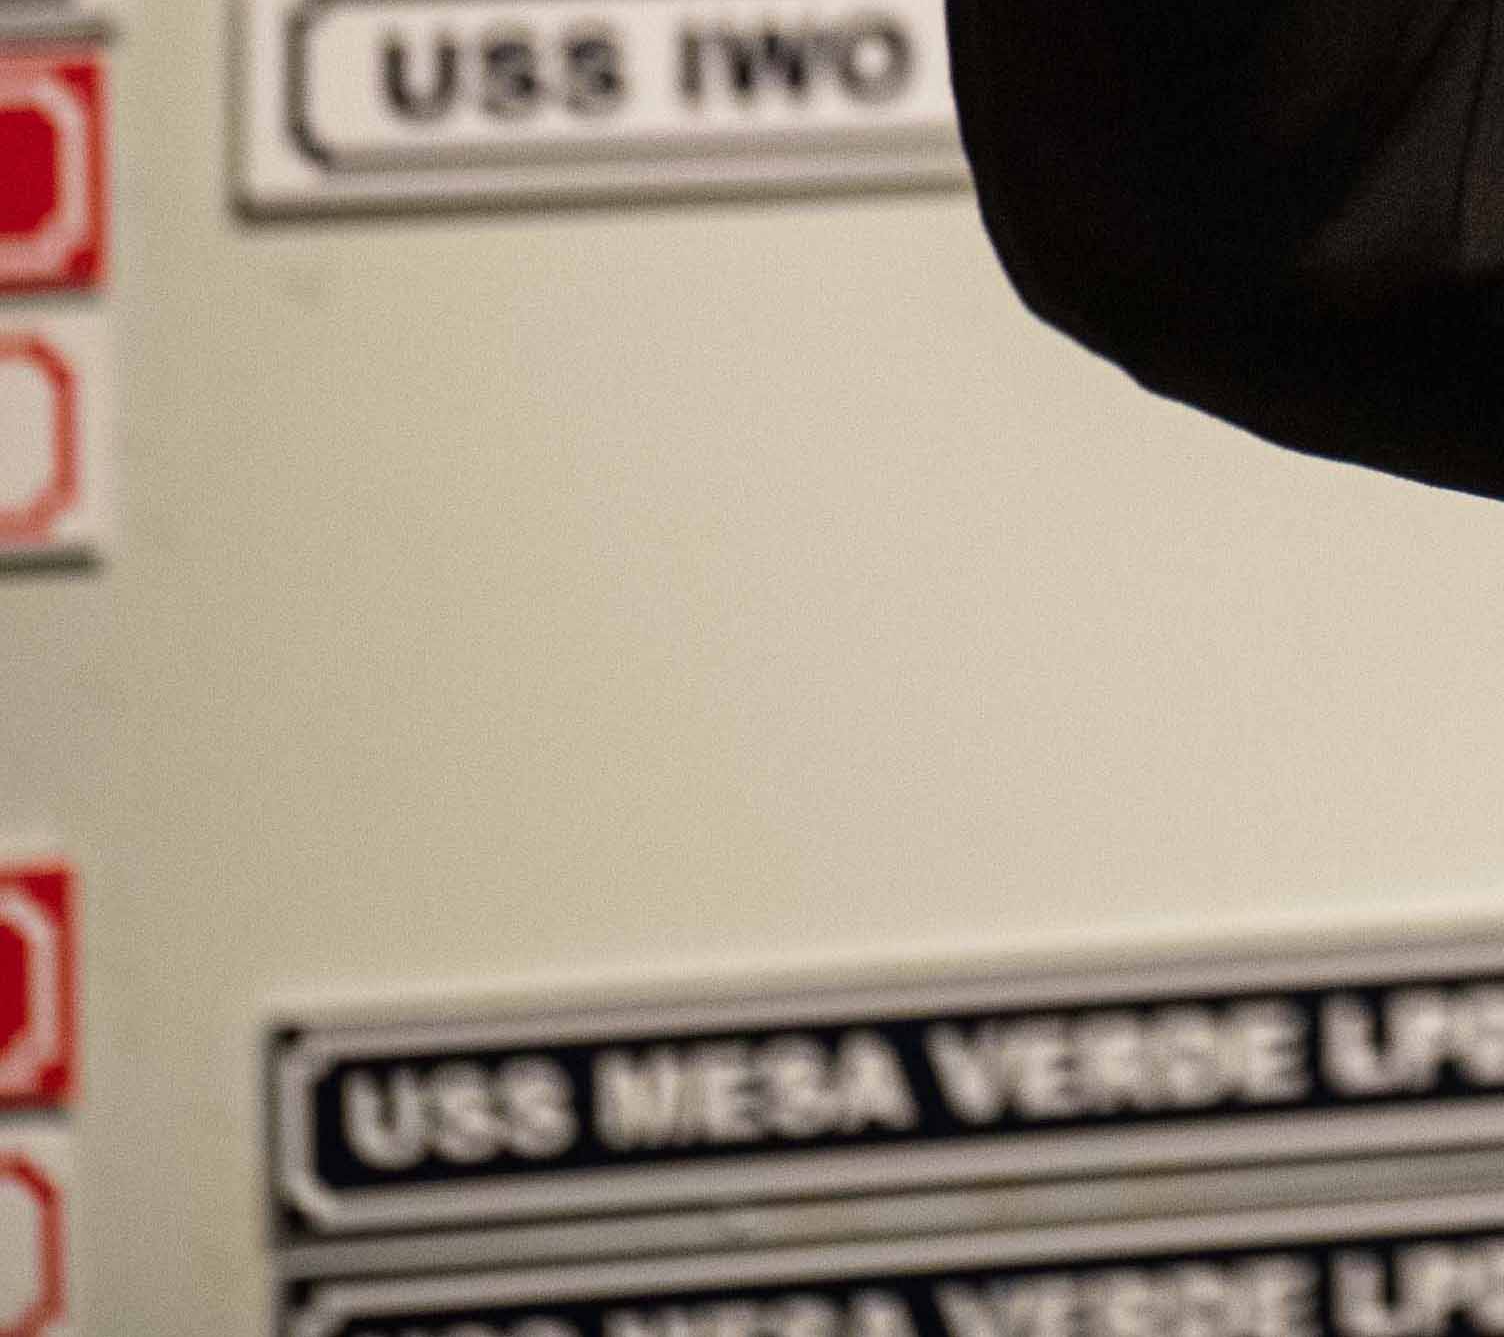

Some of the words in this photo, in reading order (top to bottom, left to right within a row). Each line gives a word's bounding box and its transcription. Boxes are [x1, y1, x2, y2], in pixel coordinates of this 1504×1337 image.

[374, 19, 627, 123] USS
[674, 9, 918, 111] IWO
[340, 1054, 584, 1173] USS
[600, 1029, 918, 1153] MESA
[924, 995, 1316, 1126] VERDE
